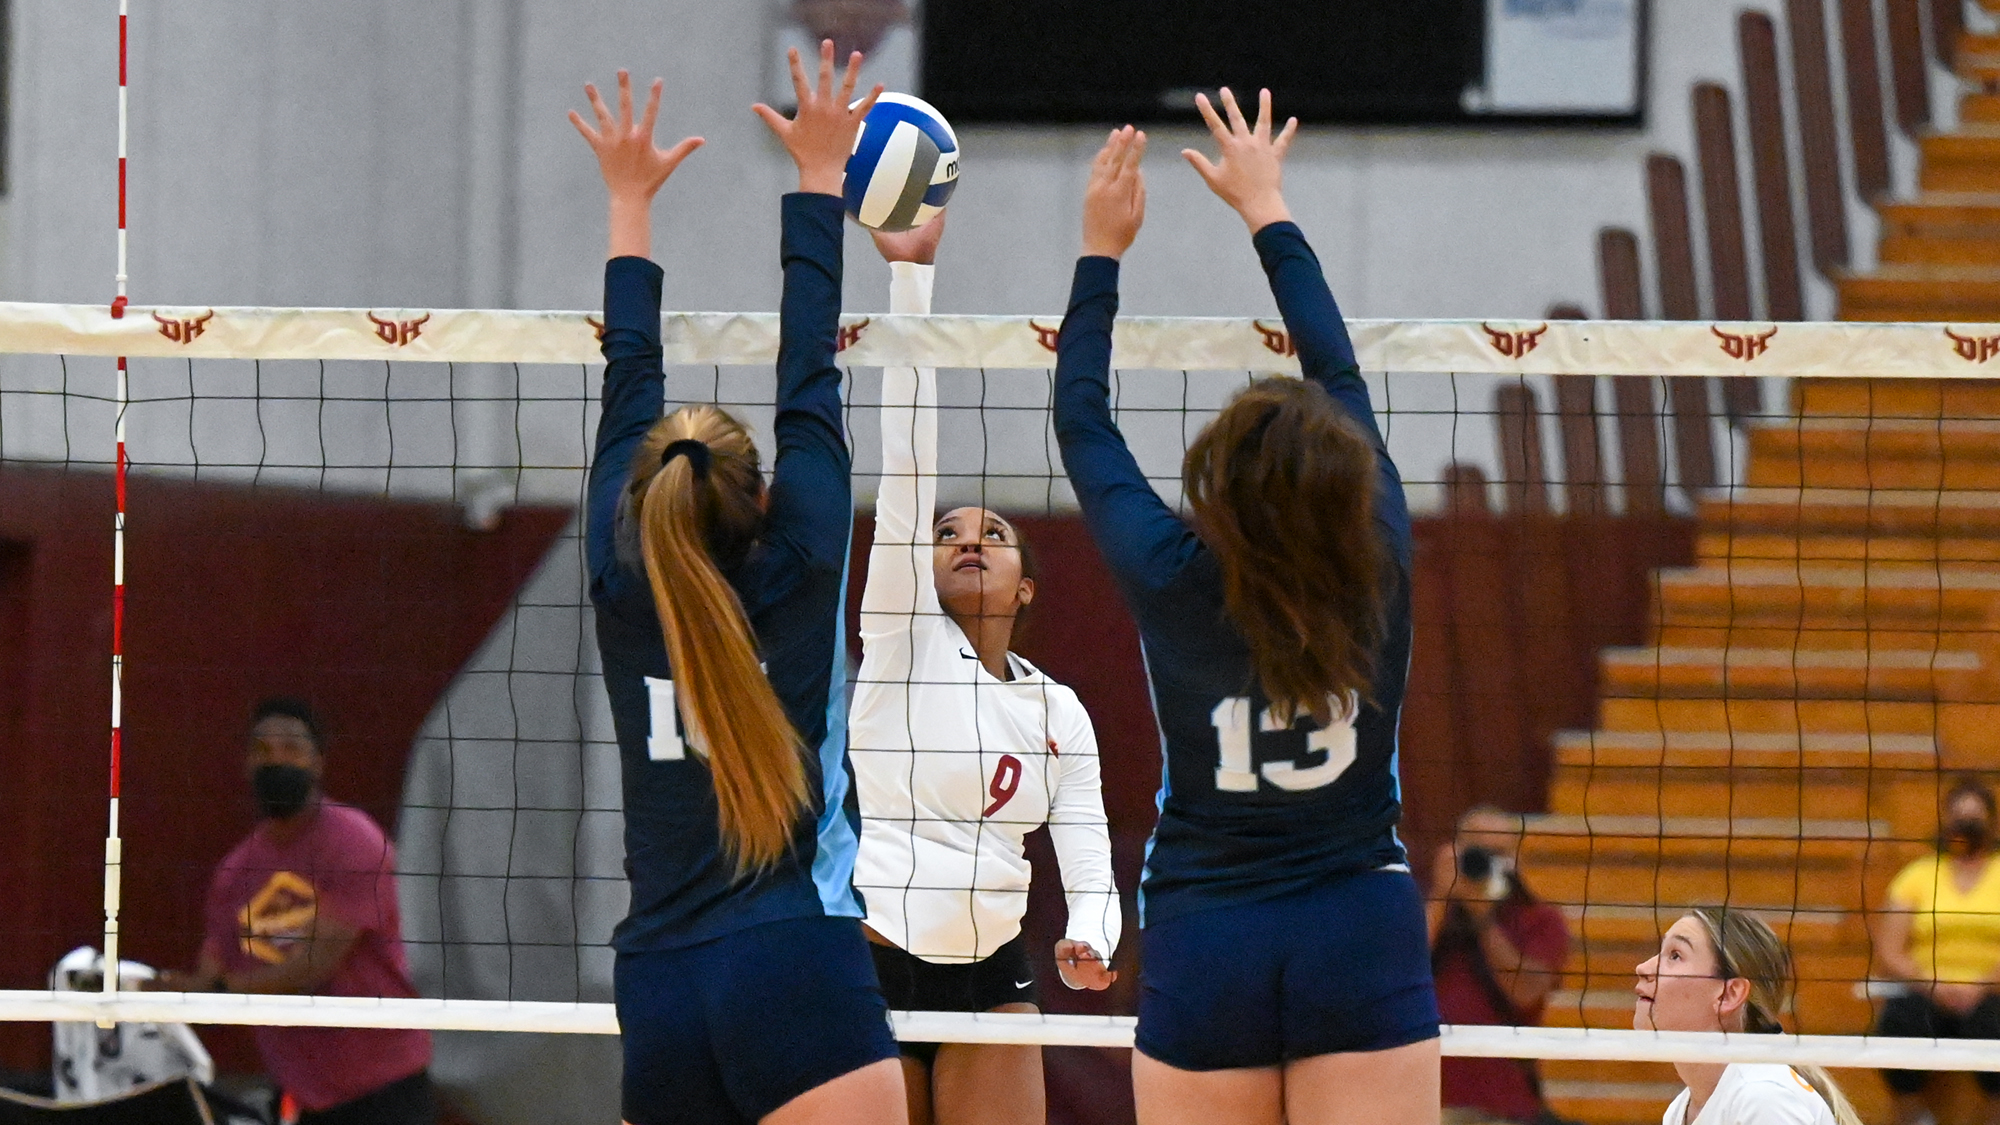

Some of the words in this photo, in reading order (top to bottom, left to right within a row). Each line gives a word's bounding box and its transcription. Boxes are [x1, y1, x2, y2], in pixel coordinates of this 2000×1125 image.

[152, 309, 213, 345] DH
[366, 310, 430, 346] DH
[837, 316, 870, 353] H
[1028, 318, 1059, 352] D
[1481, 321, 1548, 360] DH
[1710, 324, 1778, 362] DH
[1943, 326, 2000, 364] DH
[1211, 689, 1359, 792] 13
[982, 754, 1023, 818] 9
